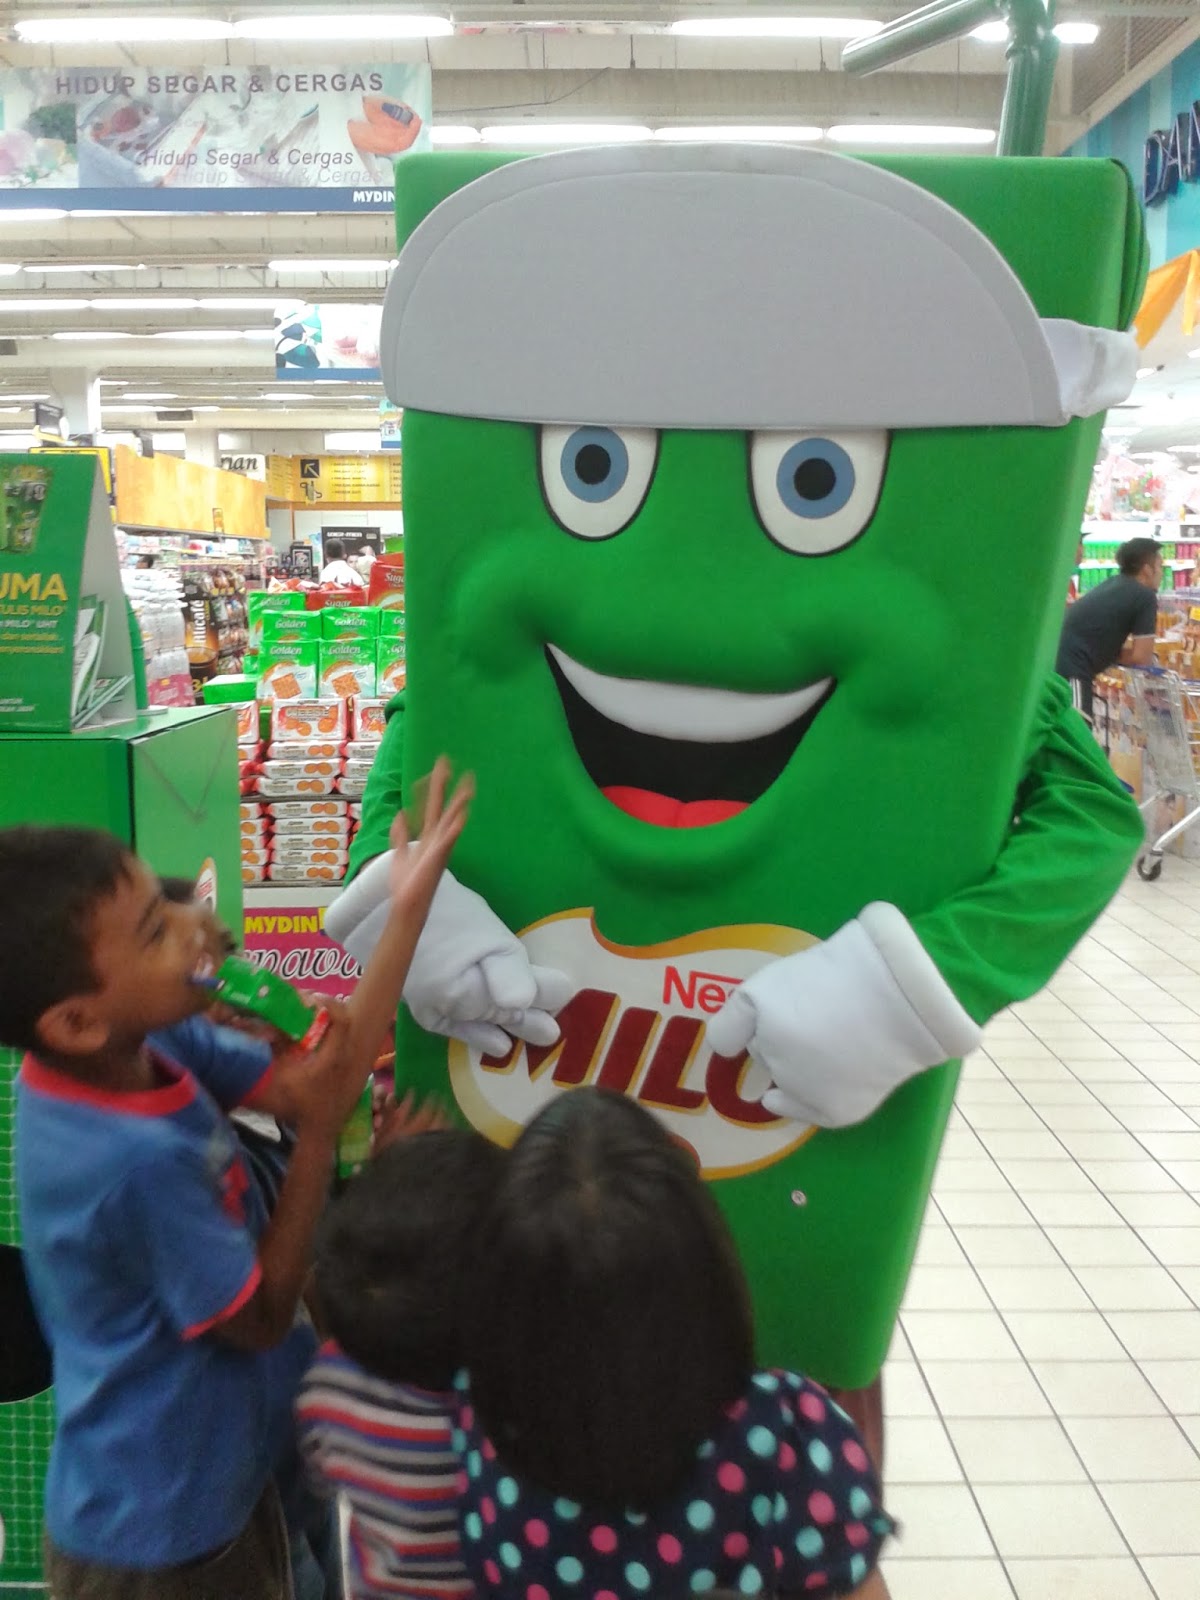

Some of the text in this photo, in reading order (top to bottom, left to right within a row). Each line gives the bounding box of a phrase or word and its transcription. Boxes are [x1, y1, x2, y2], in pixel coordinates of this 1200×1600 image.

[56, 73, 383, 95] HIDUP SEGAR & CERGAS
[144, 149, 354, 169] Hidup Segar & Cergas
[352, 190, 395, 203] MYDIN
[244, 915, 318, 934] MYDIN
[662, 966, 744, 1013] Ne
